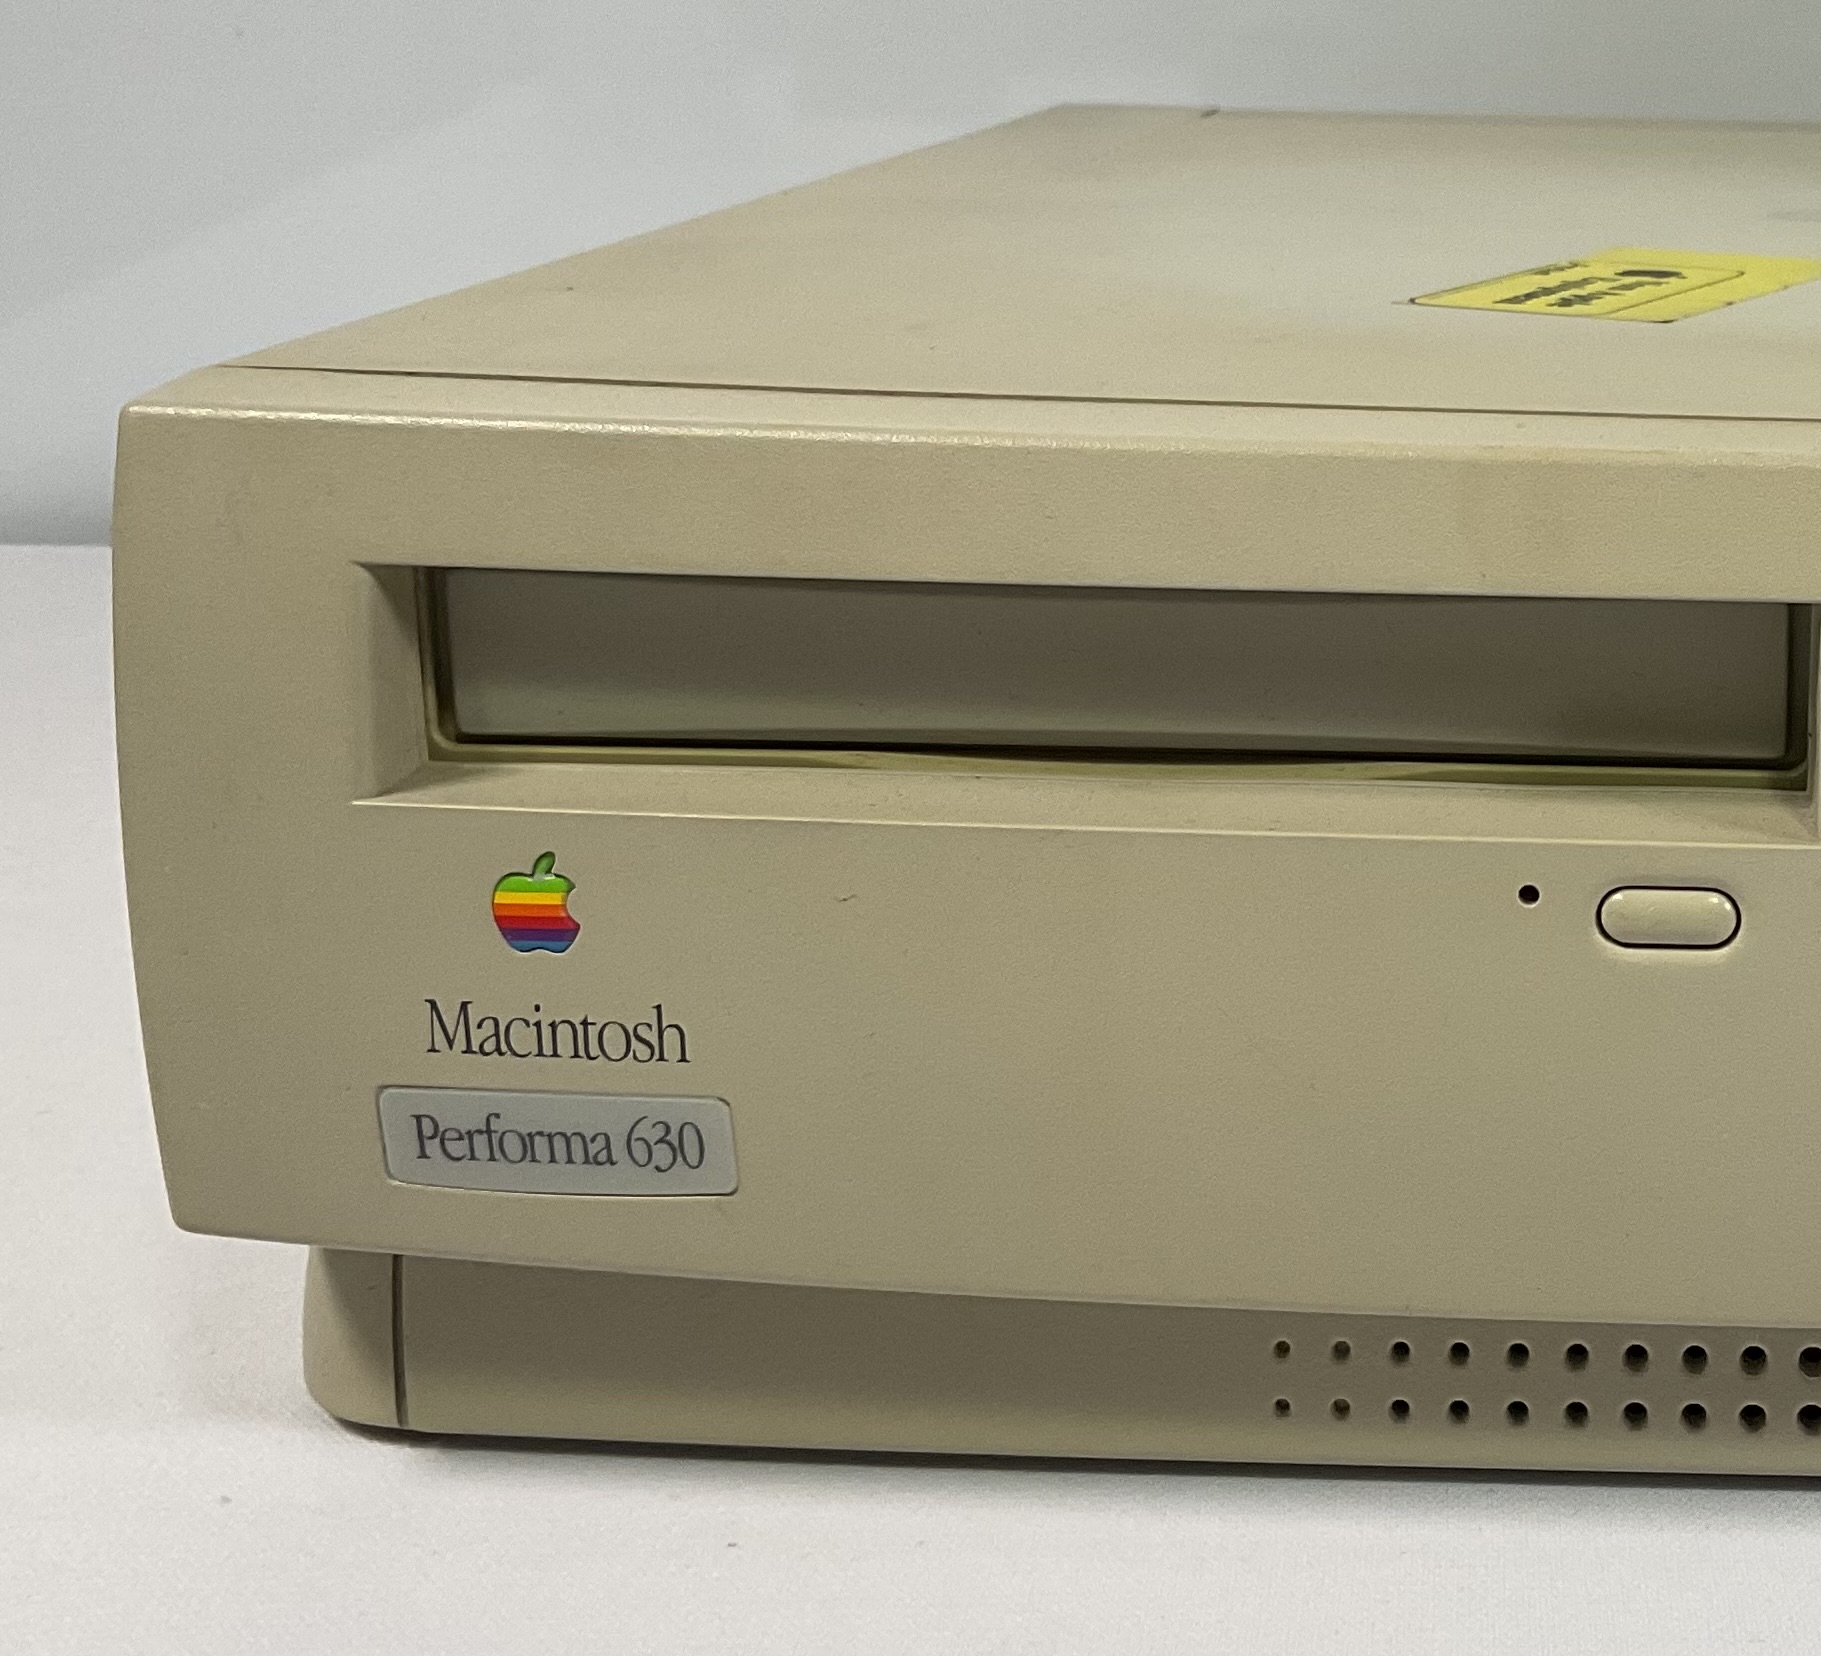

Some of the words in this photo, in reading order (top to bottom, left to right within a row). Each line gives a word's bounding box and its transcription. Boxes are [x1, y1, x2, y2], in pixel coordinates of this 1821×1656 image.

[424, 998, 692, 1064] Macintosh
[410, 1112, 618, 1166] Performa
[626, 1115, 706, 1173] 630
